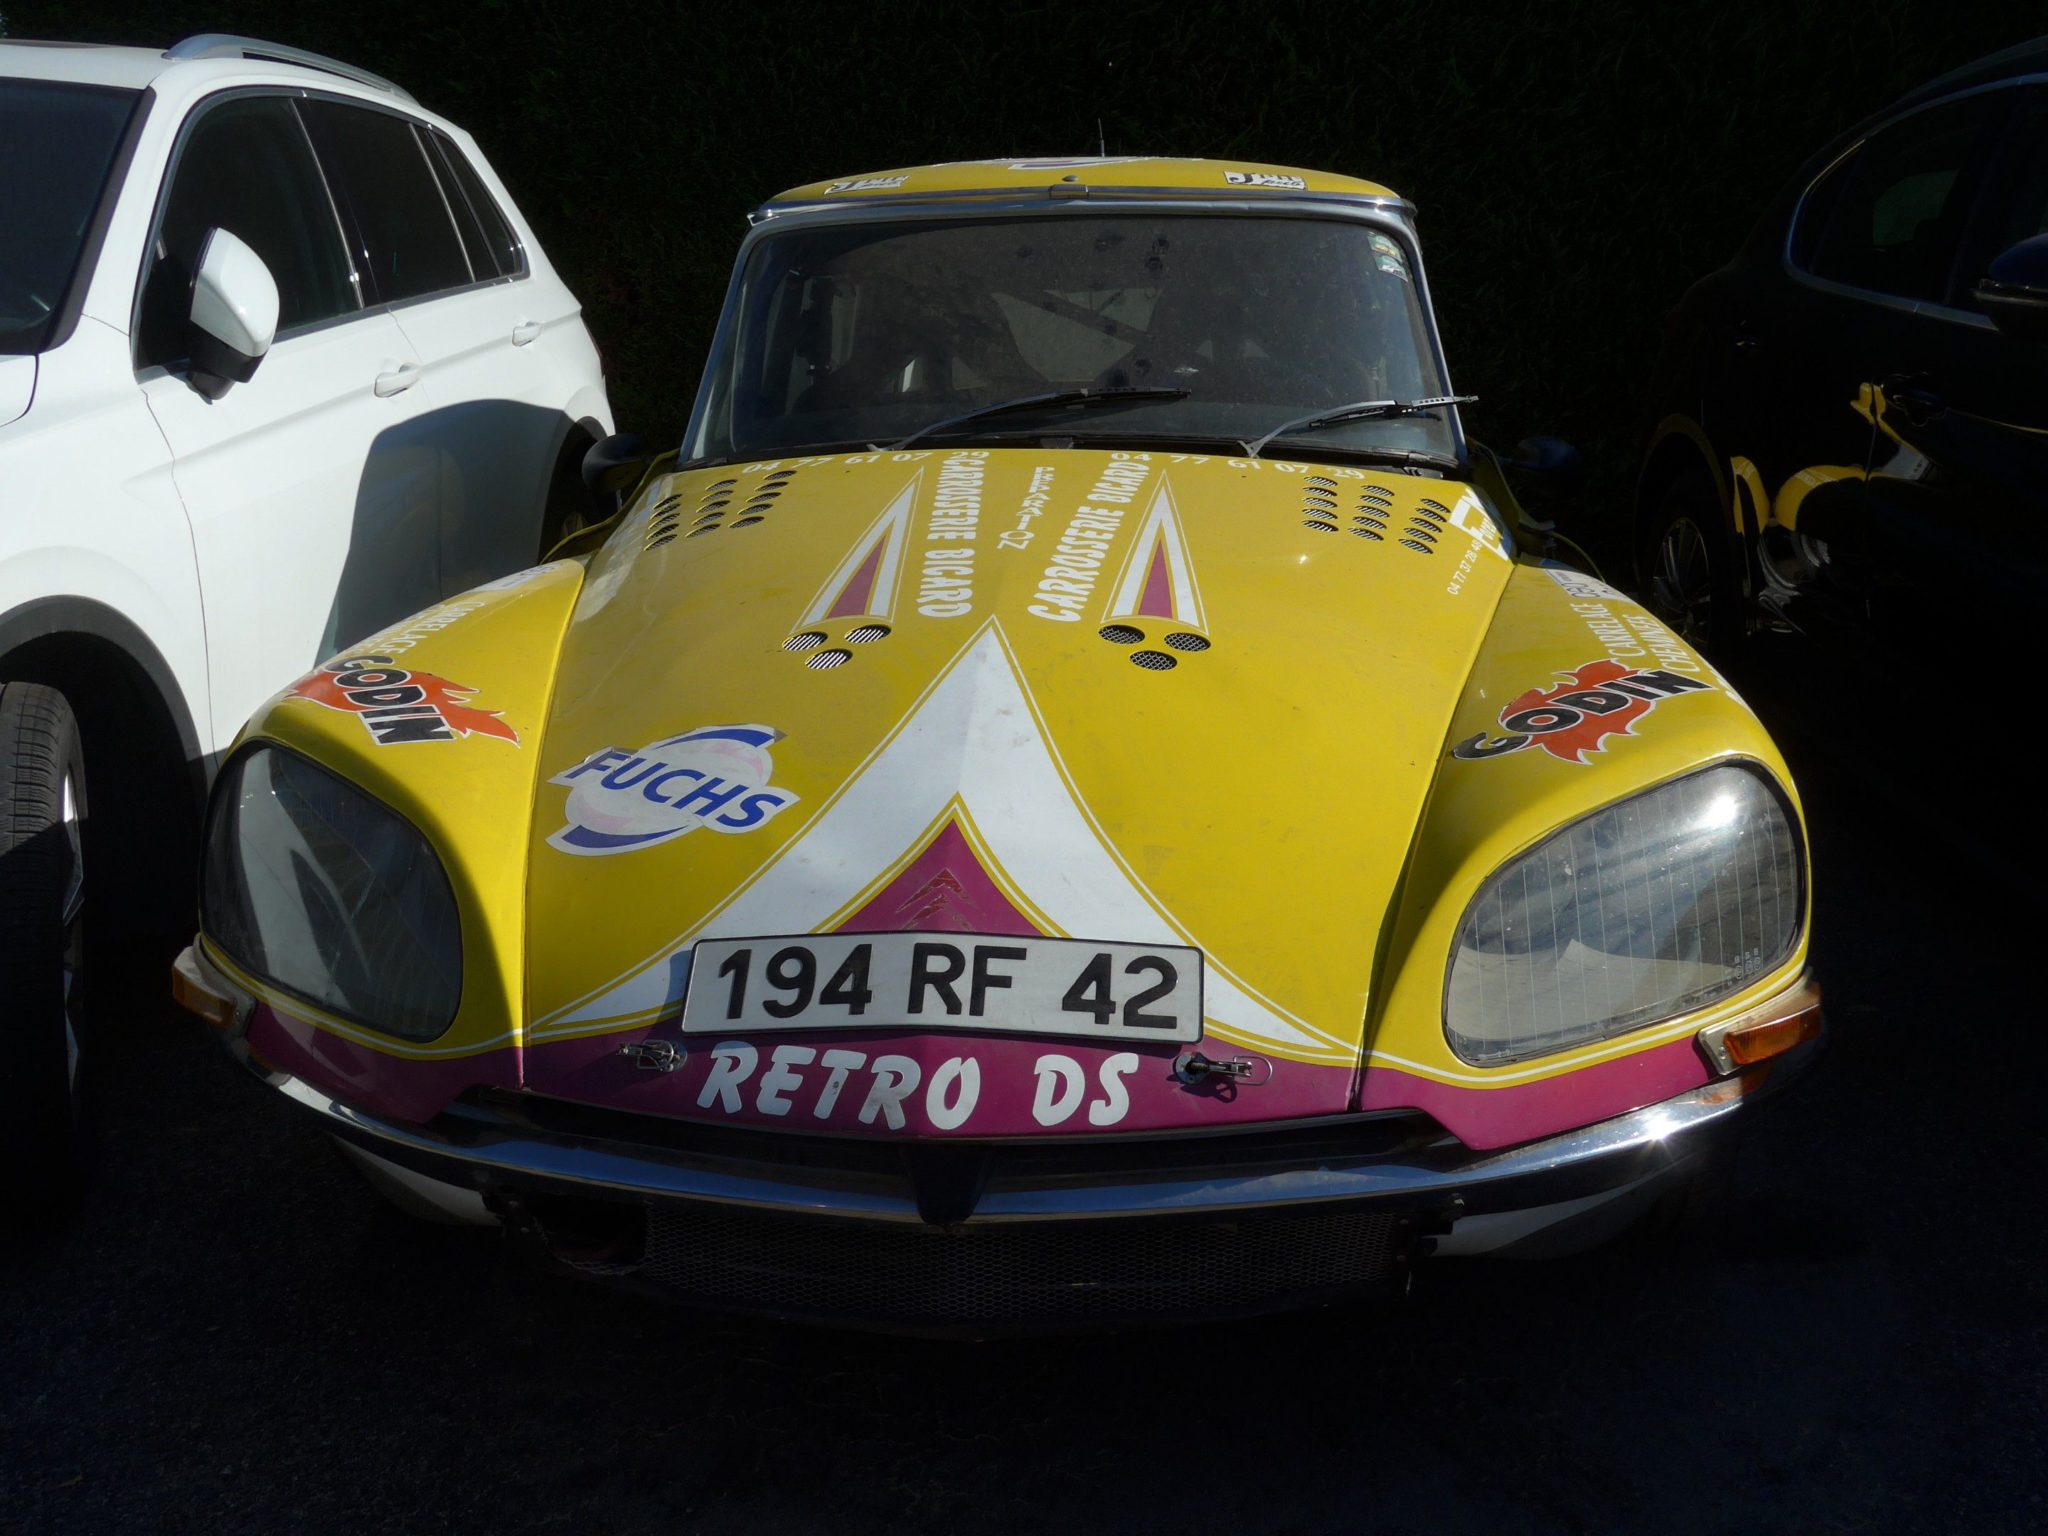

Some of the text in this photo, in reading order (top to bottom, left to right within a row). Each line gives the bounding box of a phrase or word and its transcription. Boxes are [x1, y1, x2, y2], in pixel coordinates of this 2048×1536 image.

[742, 451, 990, 474] 04 77 61 07 29
[1111, 452, 1366, 479] 04 77 61 07 29
[916, 459, 985, 618] CARROSSERIE BICARD
[1027, 461, 1150, 622] CARROSSERIE BICARD
[1570, 603, 1646, 657] CARRELAGE
[325, 656, 454, 745] GODIN
[1453, 670, 1714, 759] GODIN
[565, 750, 786, 828] FUCHS
[718, 941, 1178, 1029] 194 RF 42
[696, 1041, 1139, 1131] RETRO DS
